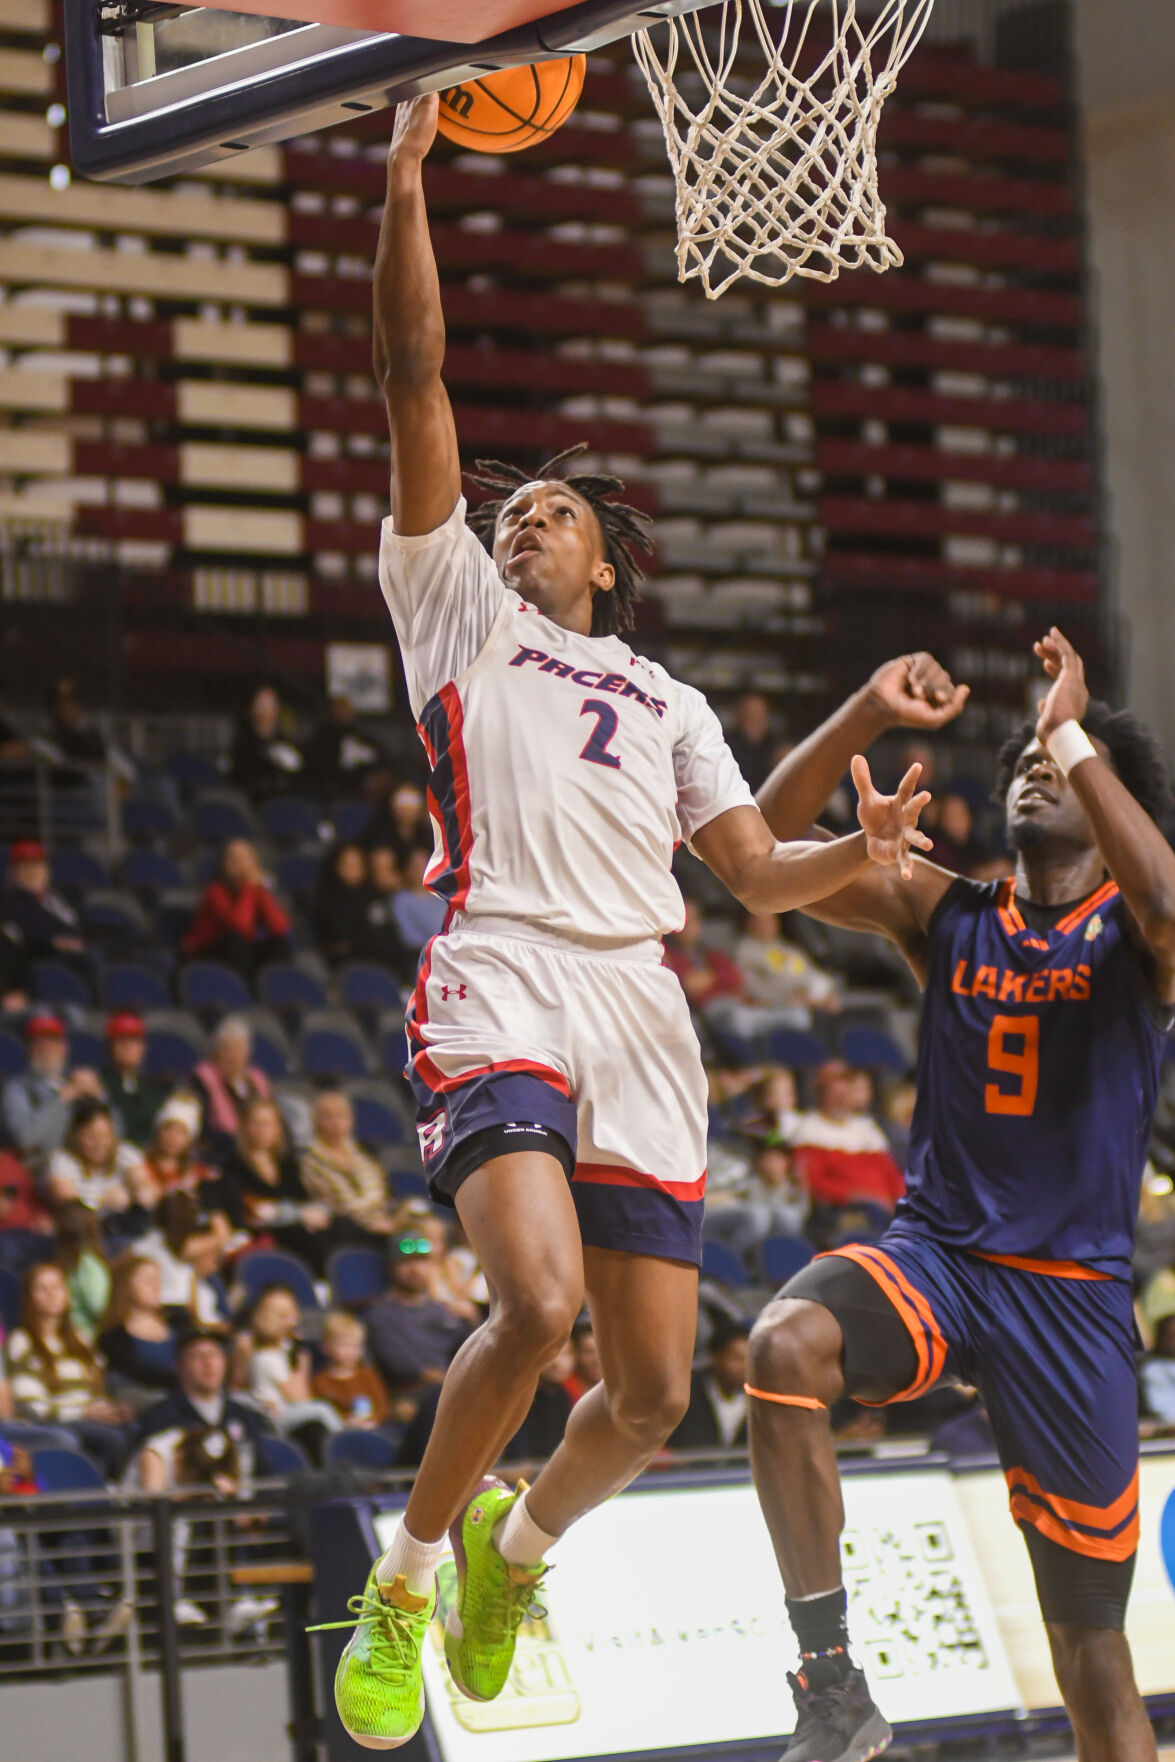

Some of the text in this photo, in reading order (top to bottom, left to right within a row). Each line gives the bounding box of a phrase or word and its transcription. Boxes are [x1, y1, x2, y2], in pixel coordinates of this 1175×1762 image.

[508, 644, 668, 718] PACERS
[579, 698, 621, 769] 2
[952, 959, 1091, 1003] LAKERS
[985, 1014, 1039, 1117] 9
